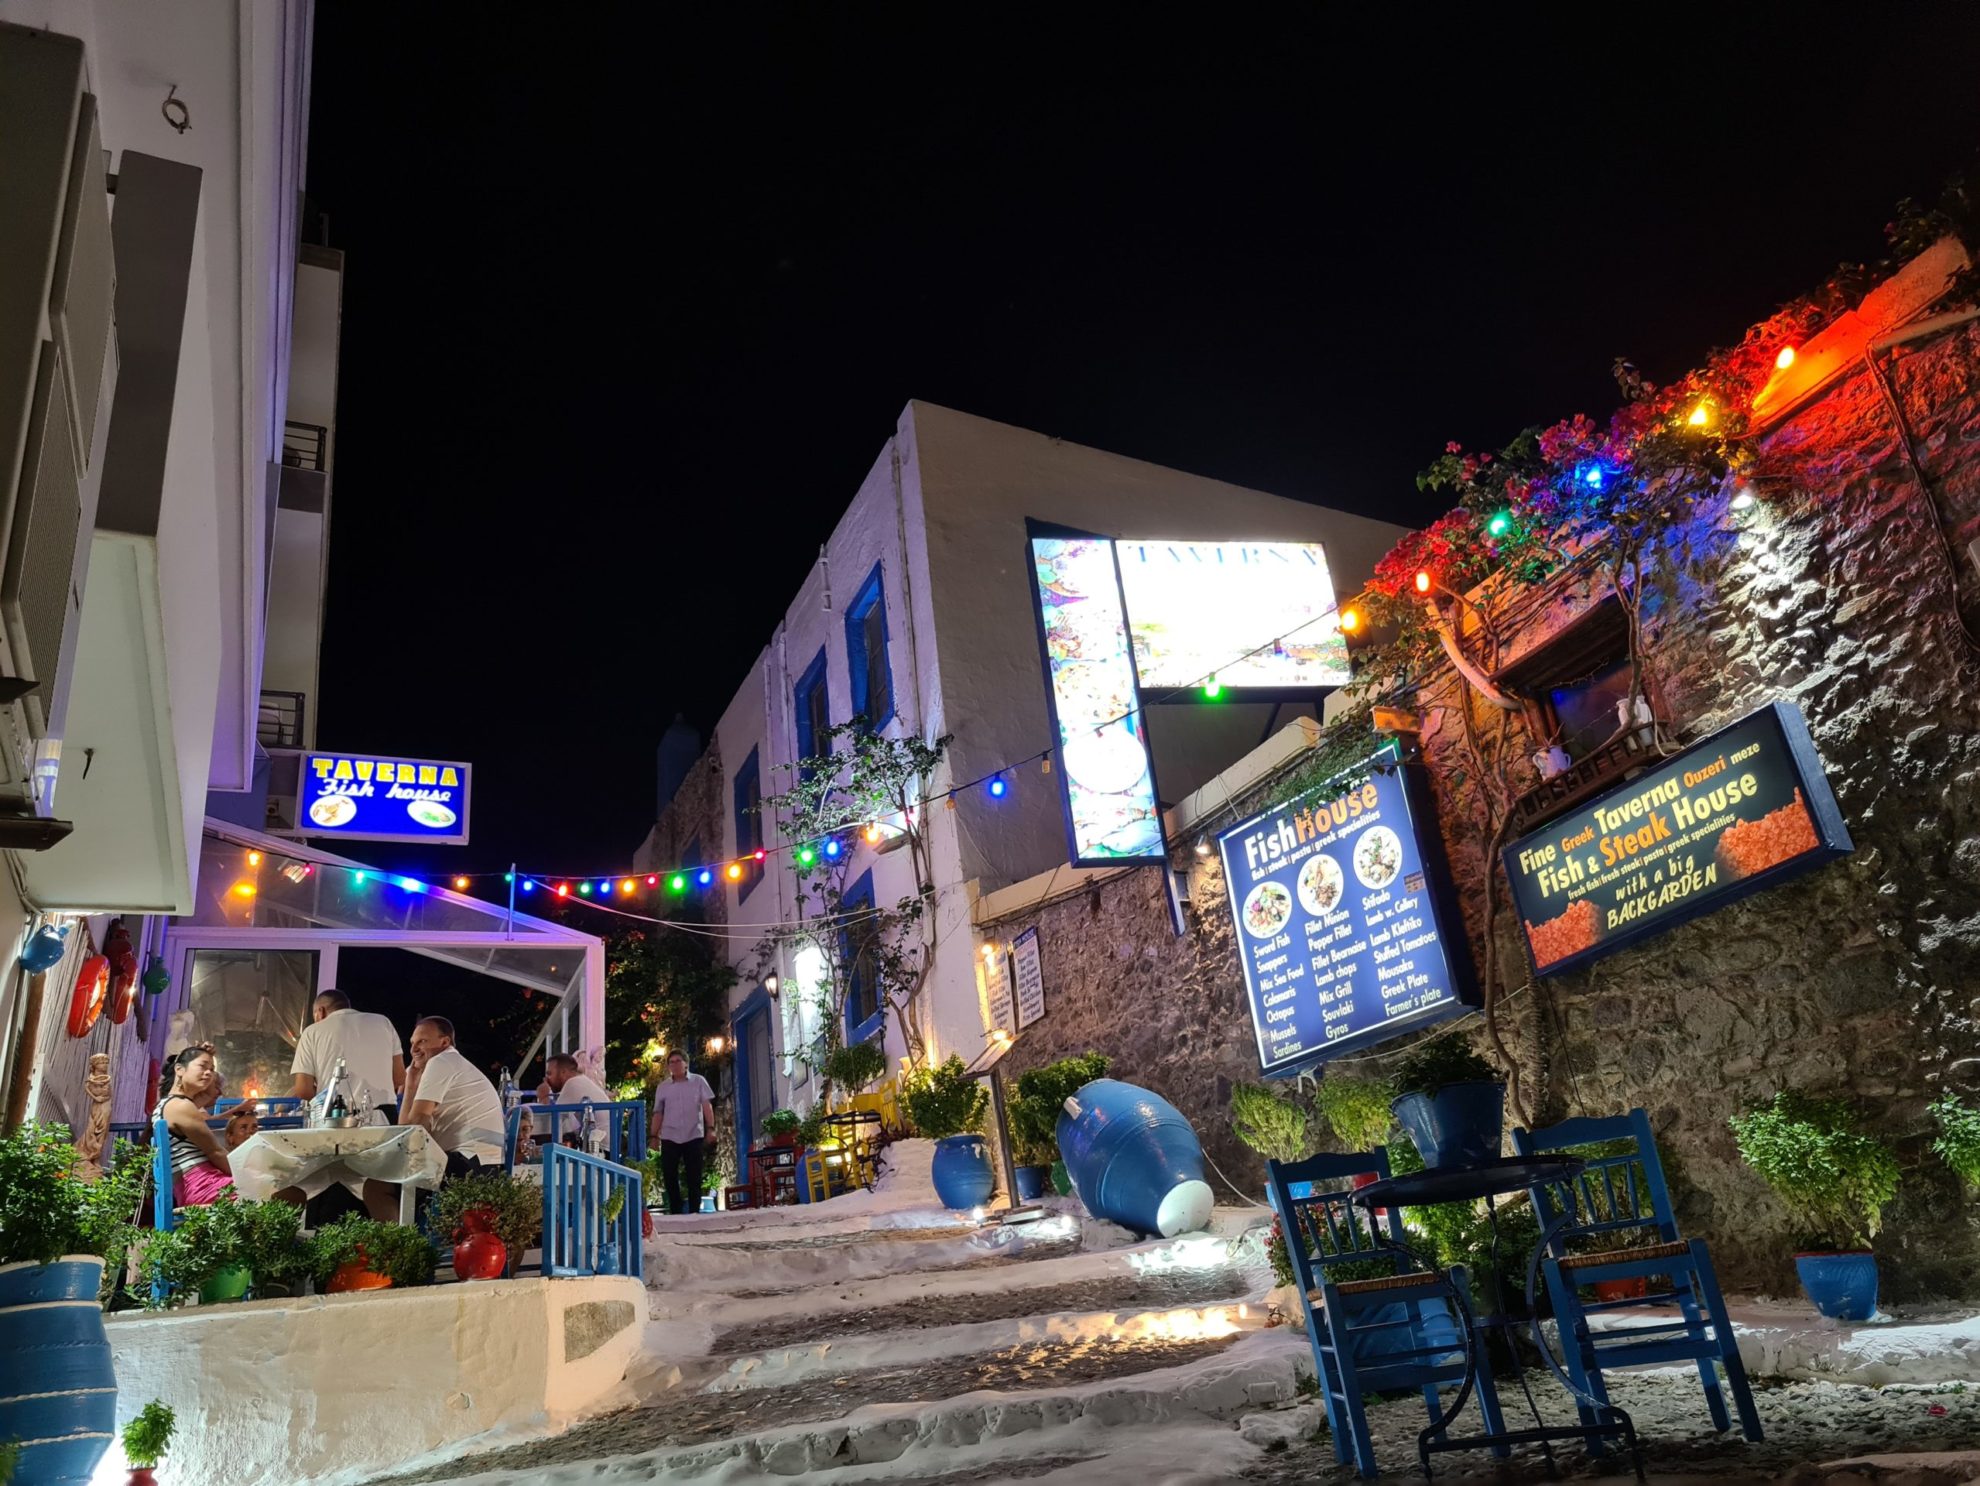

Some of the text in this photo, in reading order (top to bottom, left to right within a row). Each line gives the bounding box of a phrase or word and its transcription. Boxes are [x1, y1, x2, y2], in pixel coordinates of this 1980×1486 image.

[312, 758, 458, 786] TAVERNA
[317, 778, 451, 802] Fish house
[1518, 742, 1760, 875] Fine Greek Taverna Ouzeri meze
[1252, 810, 1380, 881] fish steak pasta greek specialities
[1537, 772, 1758, 898] Fish & Steak House
[1568, 813, 1736, 901] fresh fish fresh steak pasta greek specialities
[1616, 855, 1694, 901] with a big
[1362, 889, 1390, 910] Stifado
[1607, 863, 1717, 929] BACKGARDEN
[1304, 910, 1350, 936] Fillet Minion
[1365, 910, 1384, 927] Lamb
[1308, 924, 1352, 952] Pepper Fillet
[1369, 916, 1422, 947] Lamb Kleftiko
[1254, 933, 1290, 958] Sword Fish
[1312, 940, 1367, 970] Fillet Bearnaise
[1374, 931, 1436, 964] Stuffed Tomatoes
[1256, 954, 1288, 974] Snappers
[1315, 962, 1357, 987] Lamb chops
[1378, 958, 1414, 982] Mousaka
[1260, 963, 1304, 992] Mix Sea Food
[1382, 974, 1428, 999] Greek Plate
[1263, 985, 1296, 1007] Calamaris
[1319, 980, 1352, 1005] Mix Grill
[1421, 988, 1441, 1007] plate
[1266, 1006, 1294, 1023] Octopus
[1322, 1000, 1354, 1023] Souvlaki
[1270, 1022, 1296, 1043] Mussels
[1326, 1023, 1348, 1039] Gyros
[1273, 1041, 1302, 1059] Sardines
